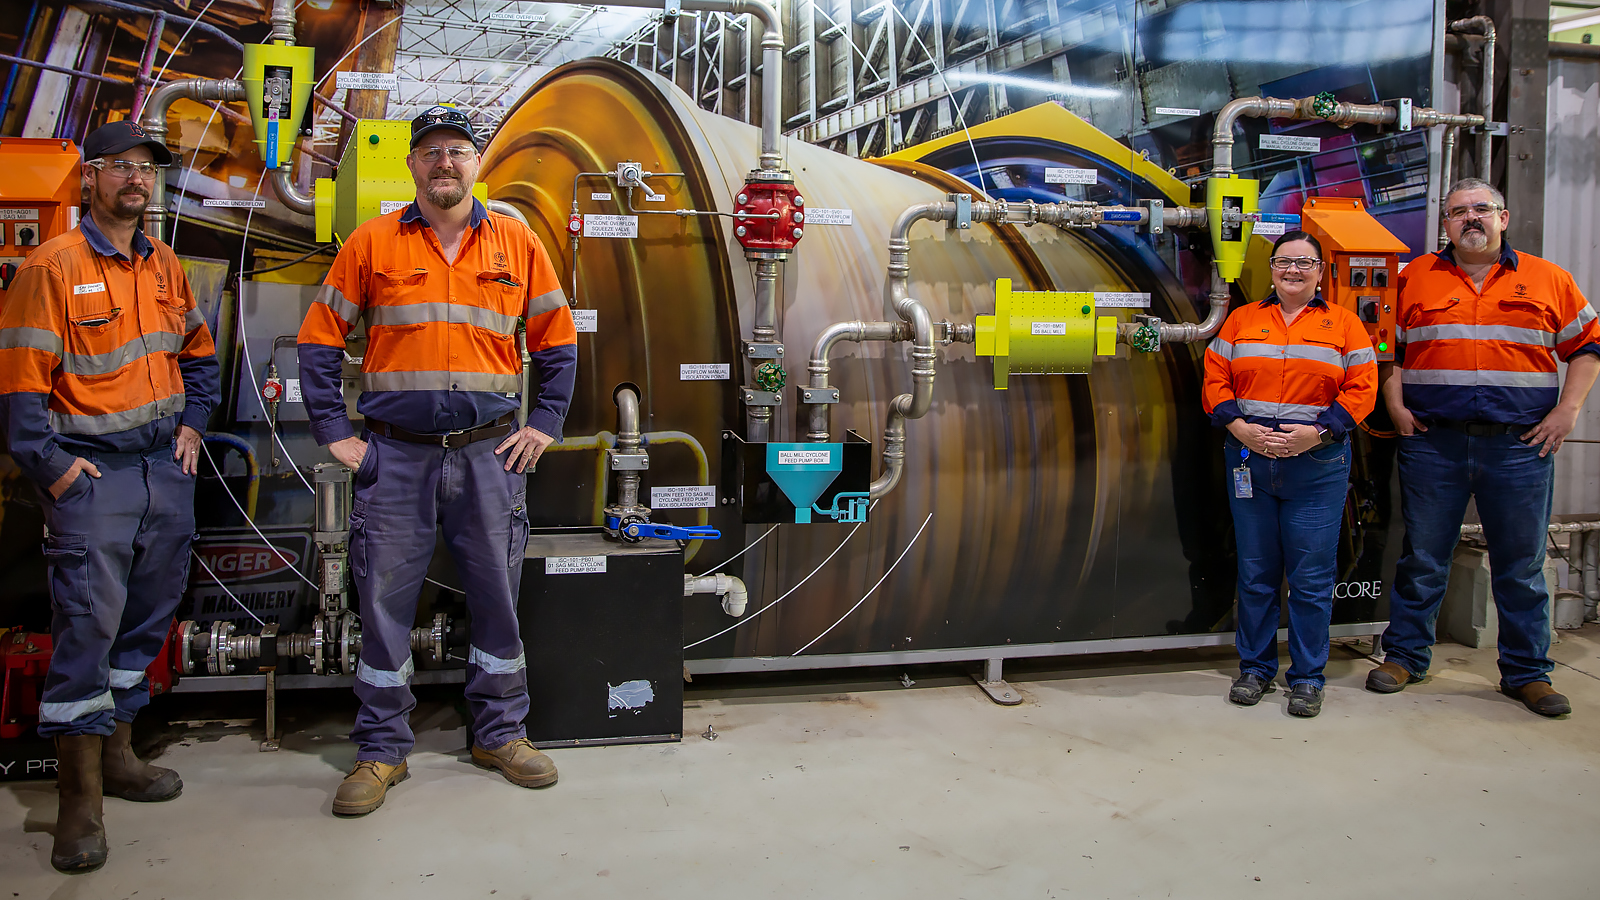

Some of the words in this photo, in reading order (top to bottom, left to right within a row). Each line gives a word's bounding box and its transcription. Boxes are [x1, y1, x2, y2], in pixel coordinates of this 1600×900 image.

[197, 552, 271, 572] NGER
[1332, 581, 1381, 599] CORE
[201, 590, 296, 614] MACHINERY
